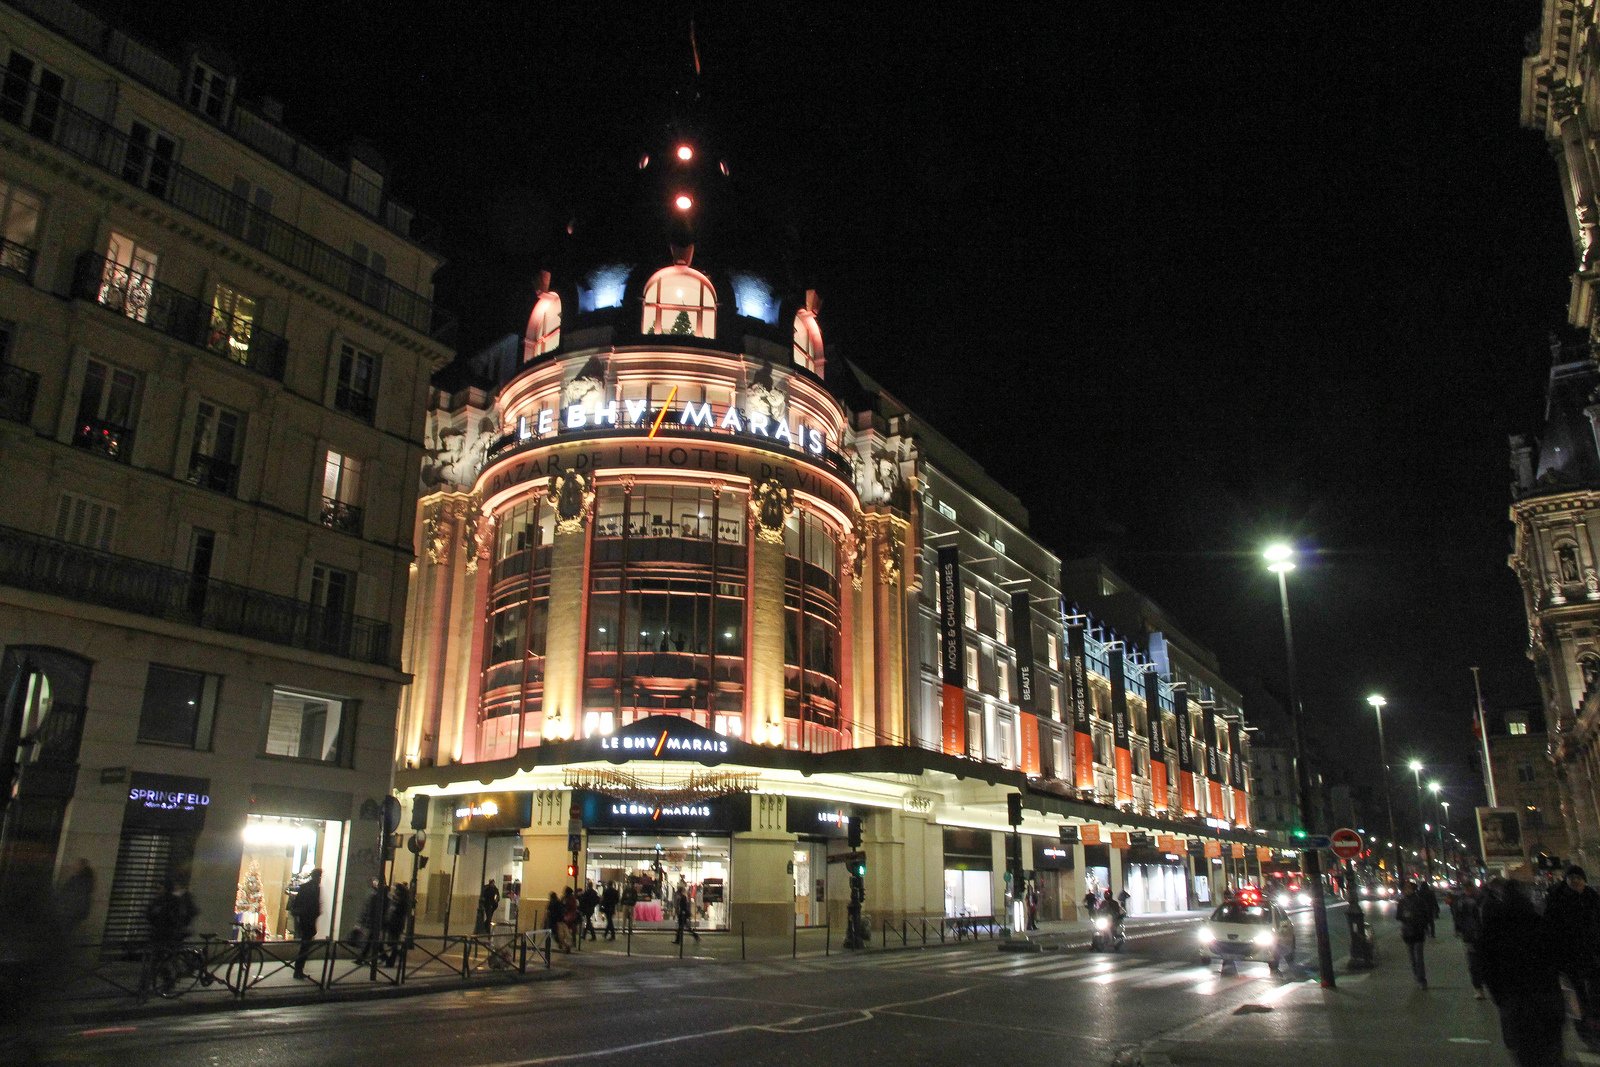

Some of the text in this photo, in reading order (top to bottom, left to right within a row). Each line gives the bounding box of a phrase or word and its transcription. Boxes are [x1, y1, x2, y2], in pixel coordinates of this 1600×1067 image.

[519, 400, 823, 454] LE BHV MARAIS
[492, 454, 560, 493] BAZAR
[576, 452, 602, 470] DE
[761, 463, 785, 480] DE
[945, 562, 956, 628] CHAUSSURES
[948, 641, 958, 671] MODE
[601, 737, 728, 753] LE BHV MARAIS
[129, 788, 210, 805] SPRINGFIELD
[612, 804, 627, 815] LE
[662, 806, 711, 817] MARAIS
